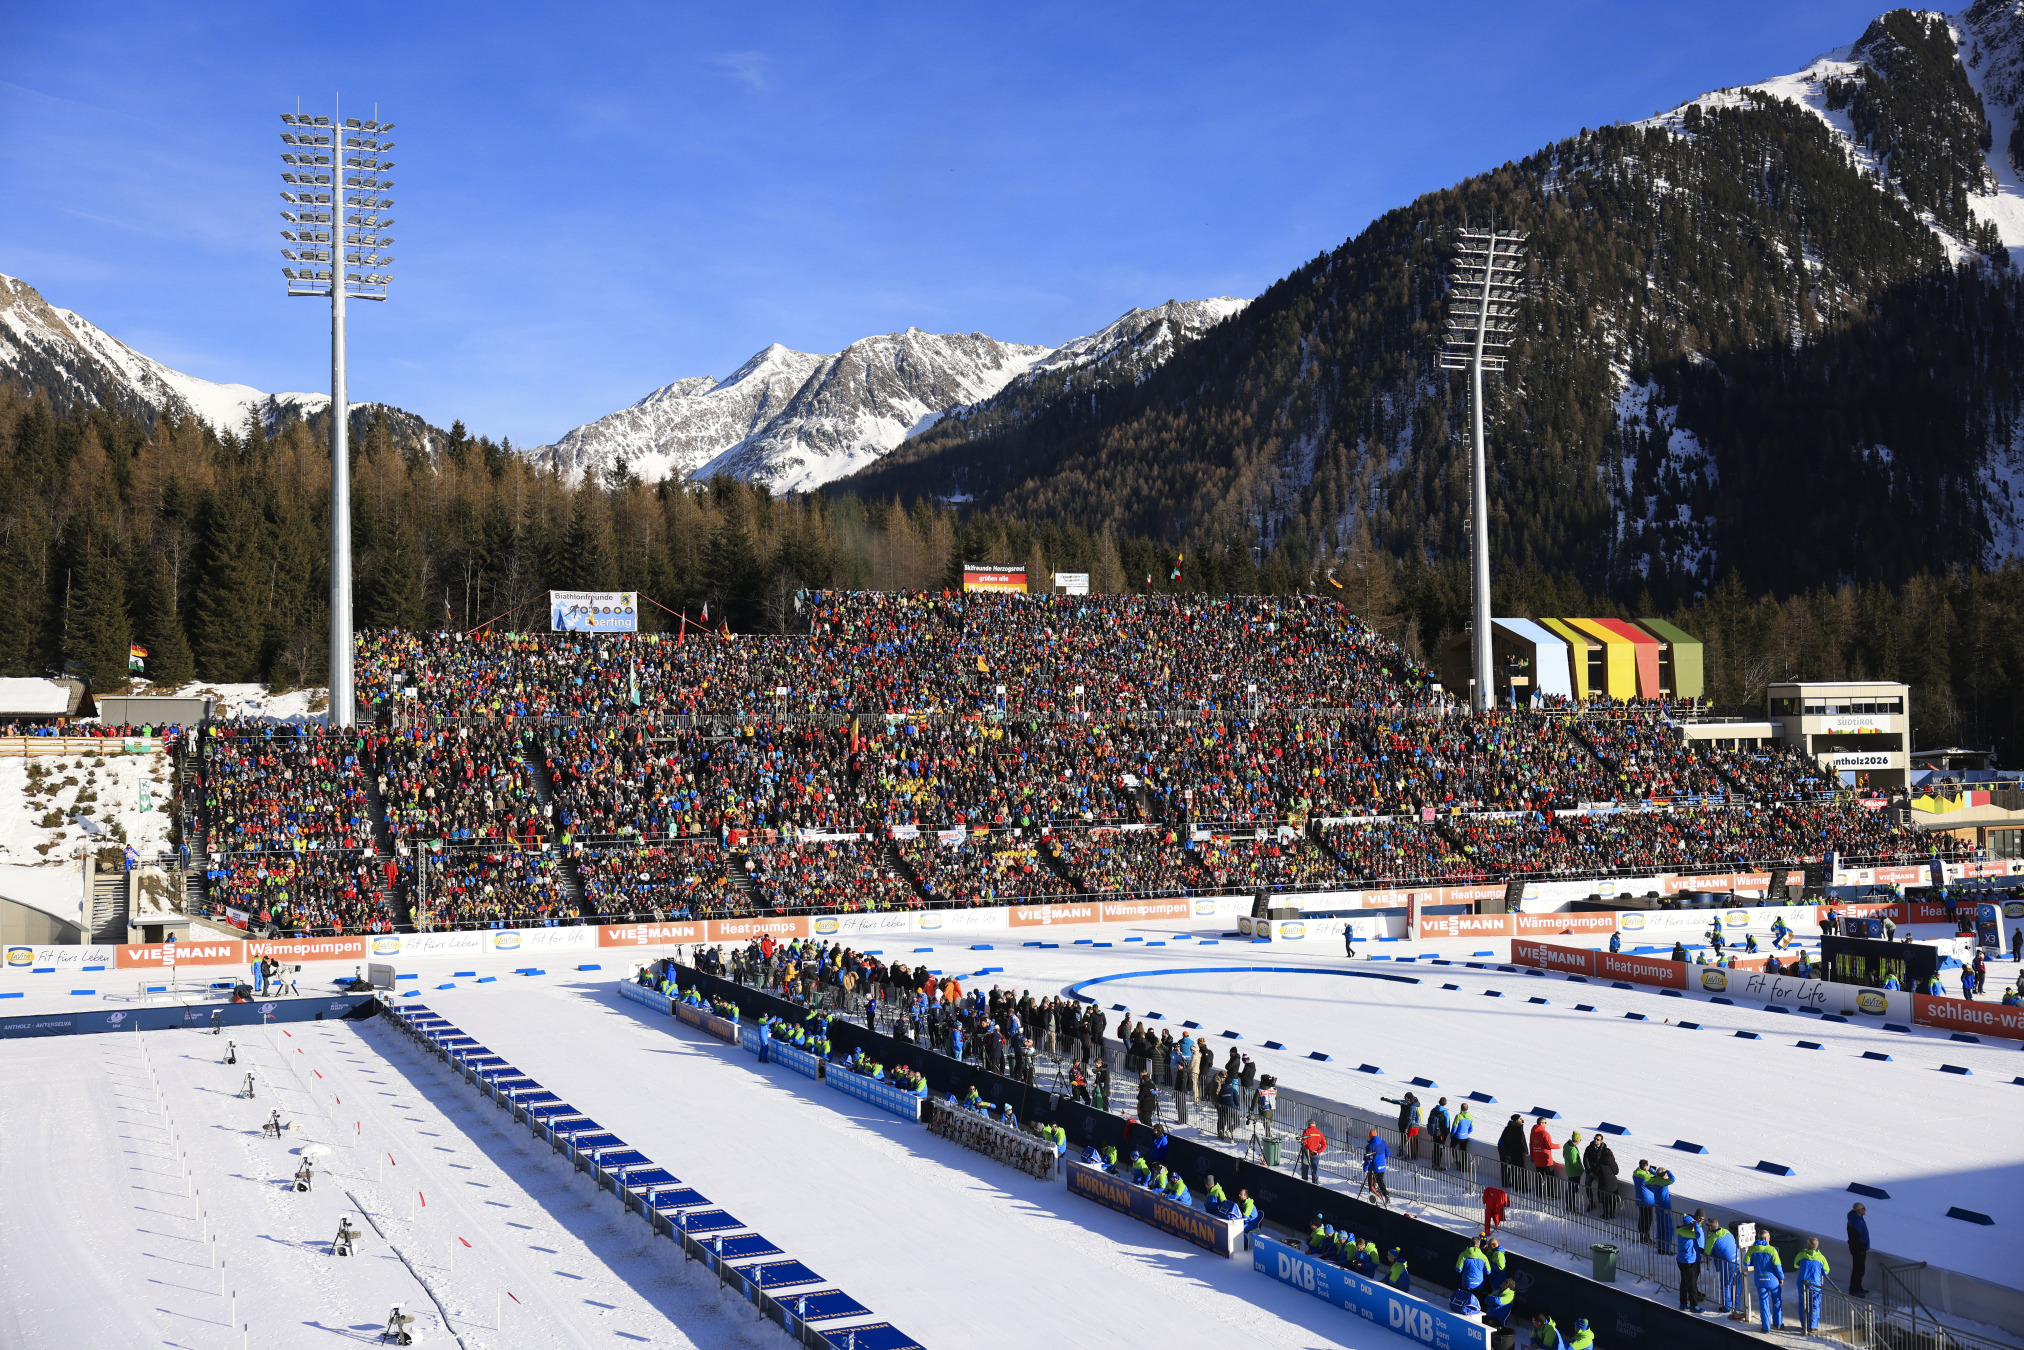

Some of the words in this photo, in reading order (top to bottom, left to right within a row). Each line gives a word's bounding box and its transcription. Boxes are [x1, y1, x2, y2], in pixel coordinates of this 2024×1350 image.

[1736, 873, 1801, 886] Wärmeppen
[1368, 890, 1432, 907] VIESSMN
[1451, 889, 1473, 899] Heat
[1017, 906, 1091, 925] VIESSMANN
[1104, 903, 1187, 917] Wärmepumpen
[1920, 905, 1947, 917] Heat
[720, 922, 750, 934] Heat
[753, 921, 796, 935] pumps
[843, 918, 857, 929] Fit
[881, 916, 906, 928] Leben
[1315, 923, 1329, 934] Fit
[1422, 916, 1504, 936] VIESSMANN
[1518, 916, 1613, 930] Wärmepumpen
[608, 924, 695, 945] VIESSMANN
[1985, 934, 1996, 943] X3
[249, 942, 362, 956] Wärmepumpen
[405, 938, 421, 949] Fit
[449, 935, 478, 948] Leben
[38, 950, 54, 962] Fit
[82, 948, 110, 962] Leben
[128, 943, 231, 966] VIESSMANN
[1518, 944, 1586, 968] VIESSMANN
[1605, 956, 1632, 973] Heat
[1633, 960, 1674, 980] pumps
[1745, 974, 1767, 994] Fit
[1771, 977, 1793, 1001] for
[1076, 1171, 1131, 1208] HÖRMANN
[1153, 1203, 1215, 1244] HÖRMANN
[1254, 1239, 1265, 1250] DKB
[1255, 1262, 1266, 1273] DKB
[1278, 1251, 1316, 1291] DKB
[1316, 1268, 1327, 1279] Das
[1317, 1278, 1329, 1289] kann
[1344, 1276, 1356, 1288] DKB
[1360, 1283, 1373, 1296] DKB
[1317, 1287, 1330, 1298] Bank
[1344, 1300, 1357, 1313] DKB
[1361, 1308, 1374, 1320] DKB
[1389, 1297, 1434, 1343] DKB
[1435, 1317, 1447, 1330] Das
[1436, 1328, 1450, 1340] kann
[1467, 1327, 1483, 1341] DKB
